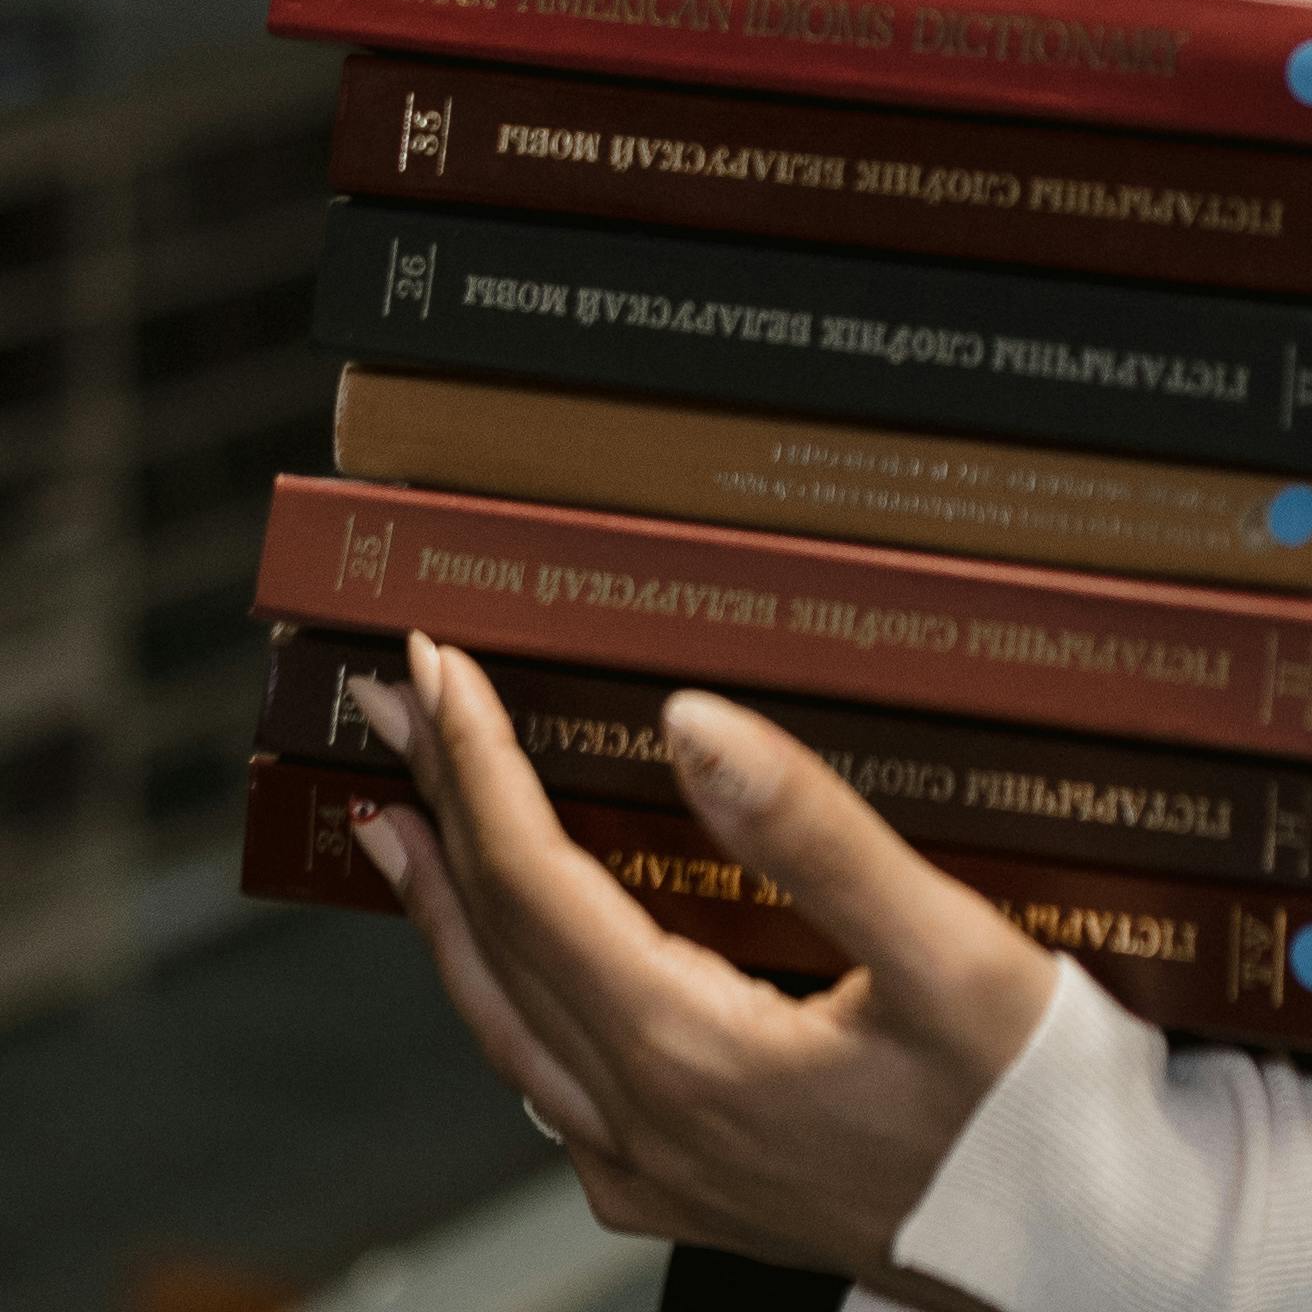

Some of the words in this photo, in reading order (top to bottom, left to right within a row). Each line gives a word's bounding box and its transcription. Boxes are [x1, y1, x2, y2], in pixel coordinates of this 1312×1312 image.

[910, 6, 1189, 76] DICTIONARY
[409, 108, 442, 157] 35
[493, 121, 601, 164] МОВЫ
[608, 131, 847, 192] БЕЛАРУСКАЙ
[394, 254, 426, 302] 26
[461, 271, 570, 317] МОВЫ
[574, 284, 812, 346] БЕЛАРУСКАЙ
[413, 544, 526, 593] МОВЫ
[534, 560, 778, 628] БЕЛАРУСКАЙ
